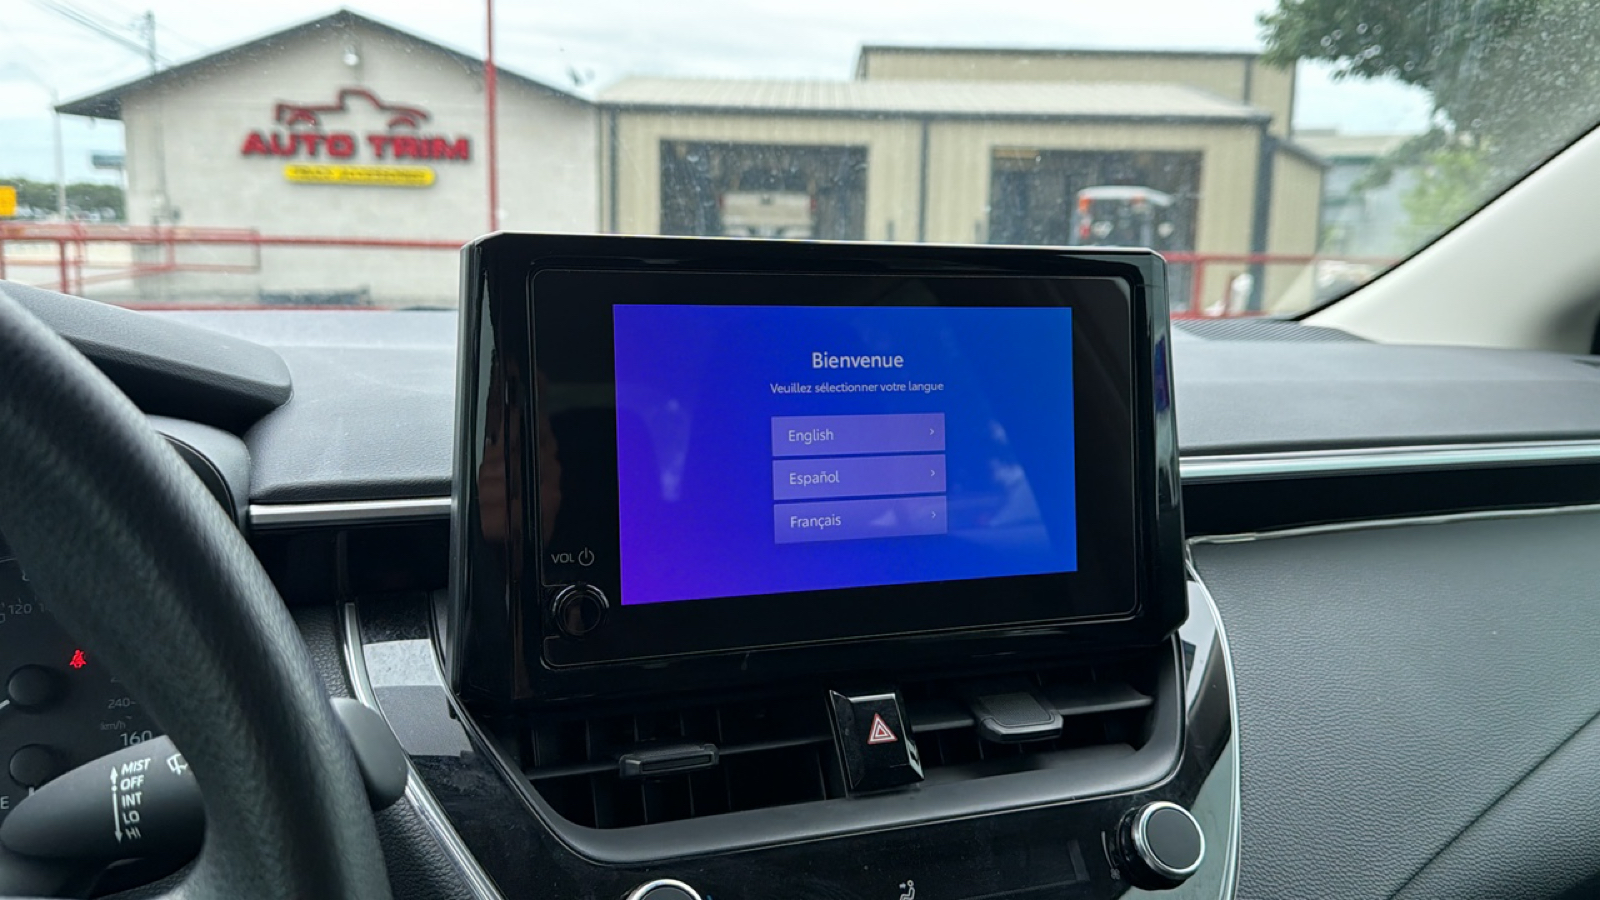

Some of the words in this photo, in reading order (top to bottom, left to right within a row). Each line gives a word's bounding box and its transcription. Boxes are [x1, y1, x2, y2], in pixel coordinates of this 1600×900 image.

[241, 131, 355, 158] AUTO
[367, 134, 470, 161] TRIM
[811, 351, 904, 369] Bienvenue
[770, 382, 812, 394] Veuillez
[814, 382, 878, 393] sélectionner
[880, 382, 907, 392] votre
[908, 381, 944, 394] langue
[788, 429, 834, 444] English
[789, 470, 840, 487] Español
[790, 514, 841, 529] Français
[551, 553, 575, 564] VOL
[8, 603, 32, 615] 120
[121, 758, 151, 776] MIST
[120, 774, 144, 790] OFF
[0, 796, 9, 809] E
[121, 792, 142, 808] INT
[123, 810, 140, 825] LO
[125, 828, 142, 839] HI
